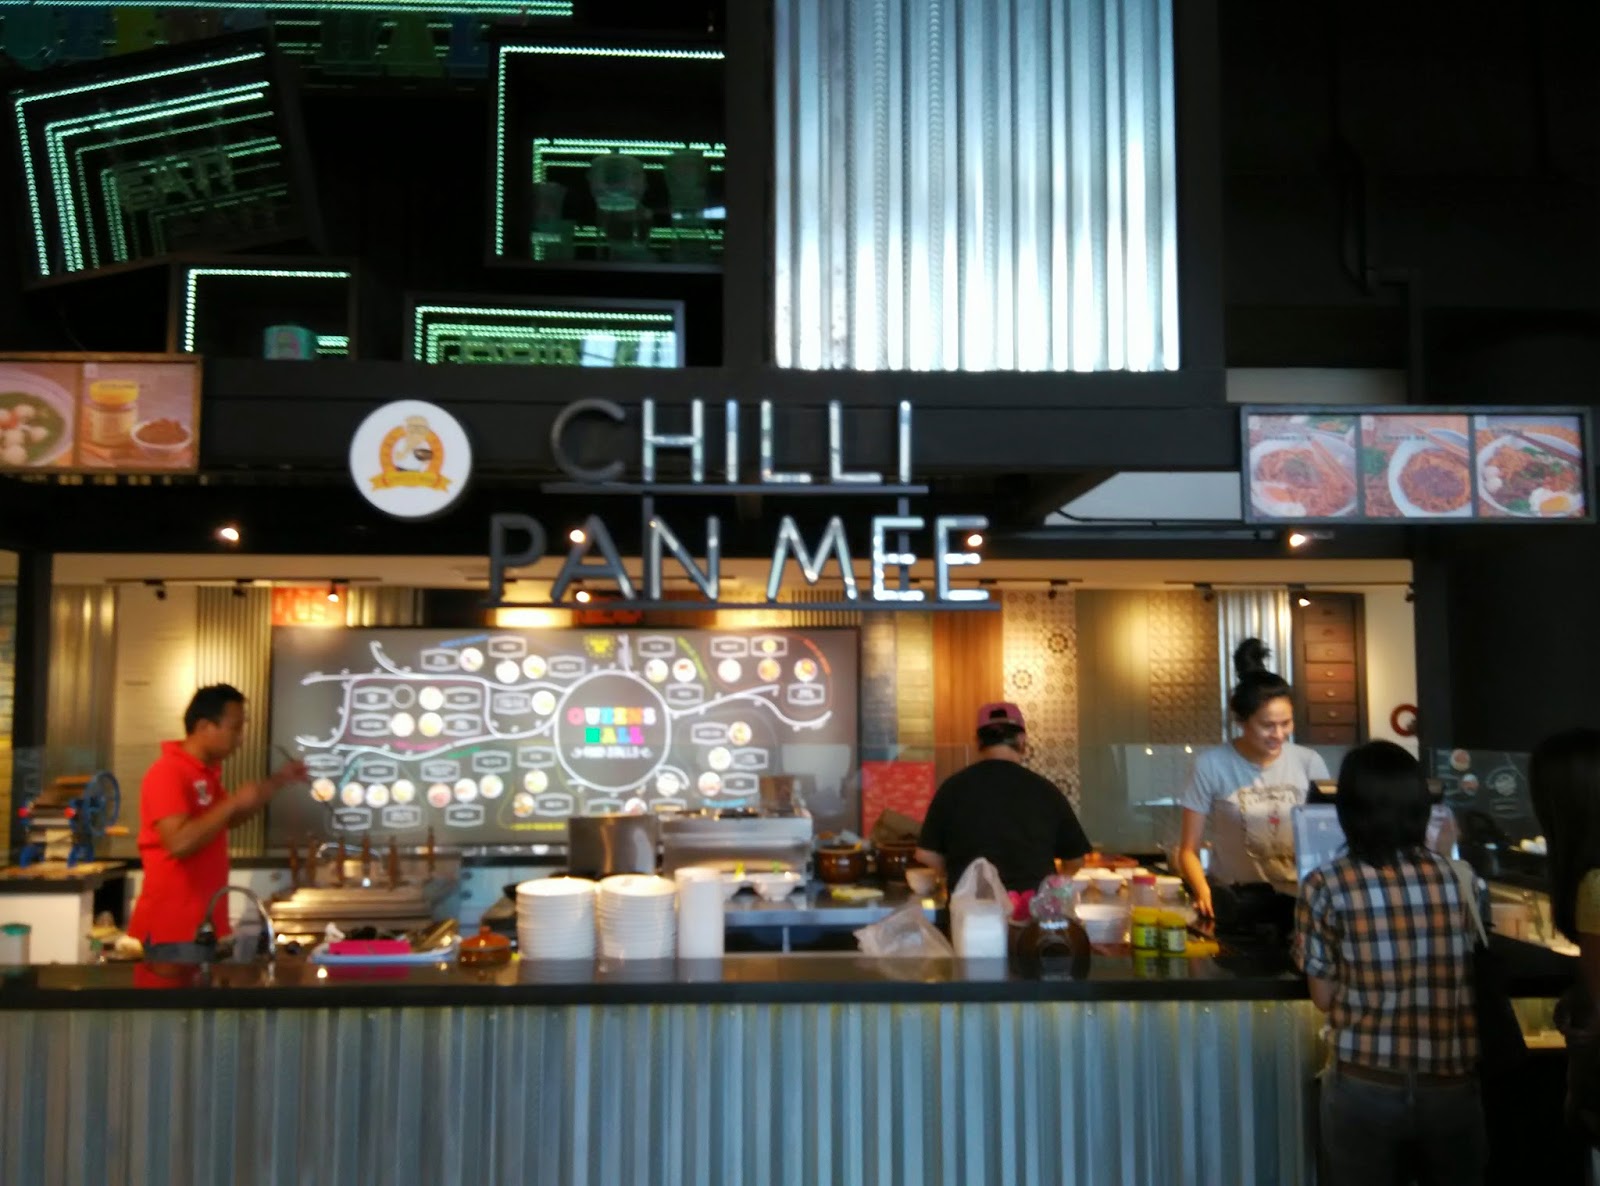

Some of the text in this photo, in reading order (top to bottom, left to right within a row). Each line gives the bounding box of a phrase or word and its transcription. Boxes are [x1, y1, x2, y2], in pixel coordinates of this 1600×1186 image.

[551, 399, 911, 484] CHILLI
[490, 514, 989, 602] PAN MEE
